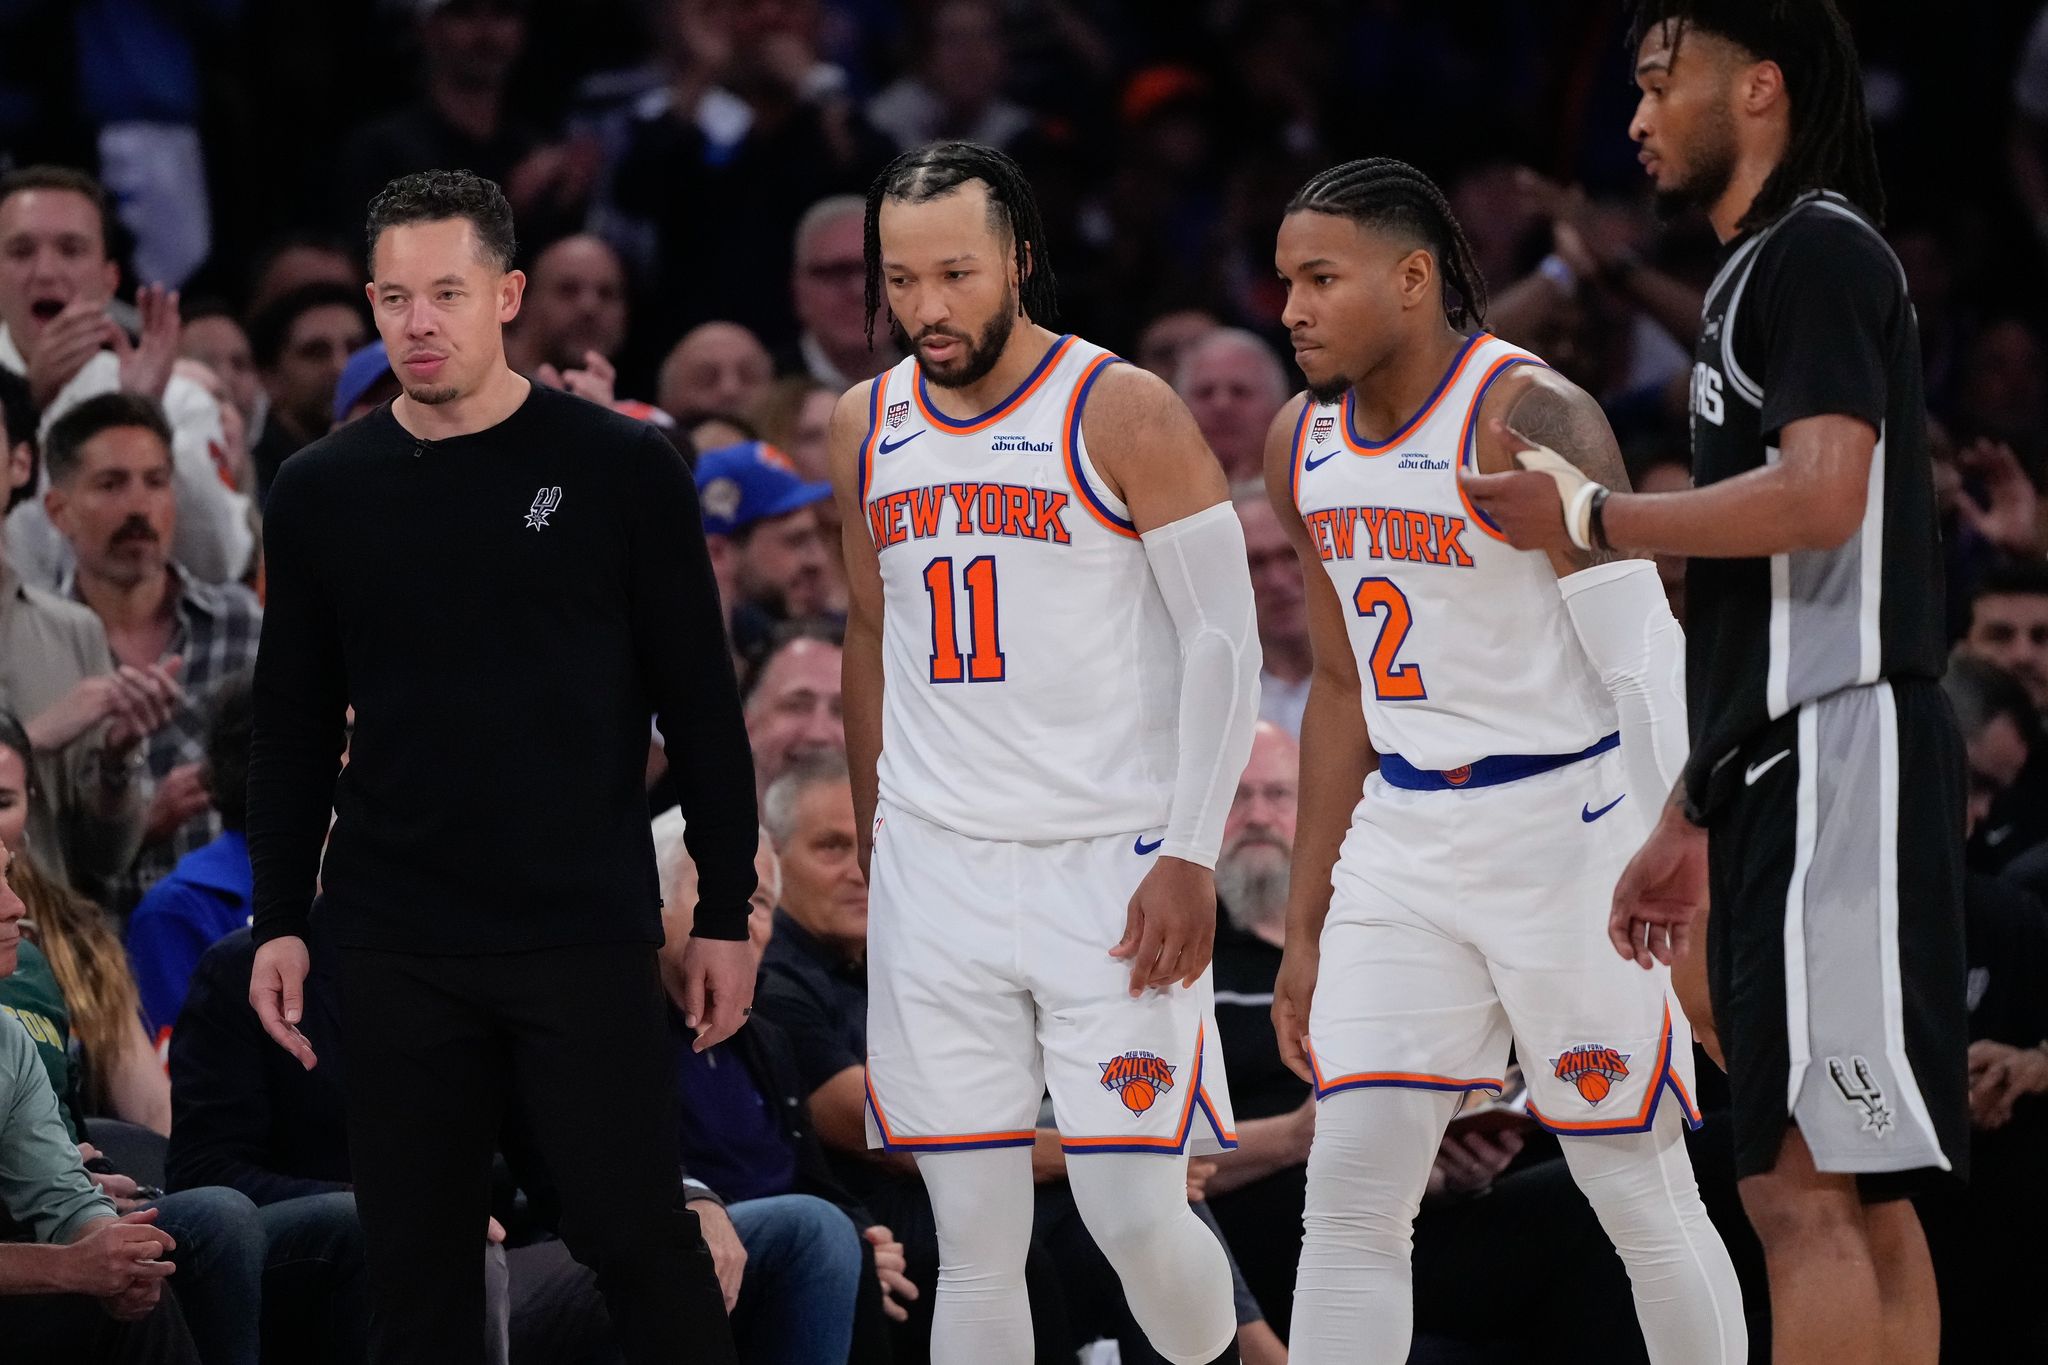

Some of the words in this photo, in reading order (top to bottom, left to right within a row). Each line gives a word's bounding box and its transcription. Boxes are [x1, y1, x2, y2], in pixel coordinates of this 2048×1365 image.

[889, 403, 908, 414] USA
[886, 414, 908, 426] 250
[1316, 419, 1333, 427] USA
[1311, 431, 1331, 439] 250
[991, 441, 1015, 451] abu
[1398, 459, 1418, 469] abu
[869, 485, 945, 551] NEW
[950, 482, 1072, 546] YORK
[1360, 506, 1476, 568] YORK
[922, 555, 1006, 684] 11
[1353, 576, 1428, 700] 2
[1124, 1050, 1138, 1058] NEW
[1139, 1050, 1155, 1058] YORK
[1555, 1047, 1630, 1078] KNICKS
[1100, 1055, 1174, 1088] KNICKS
